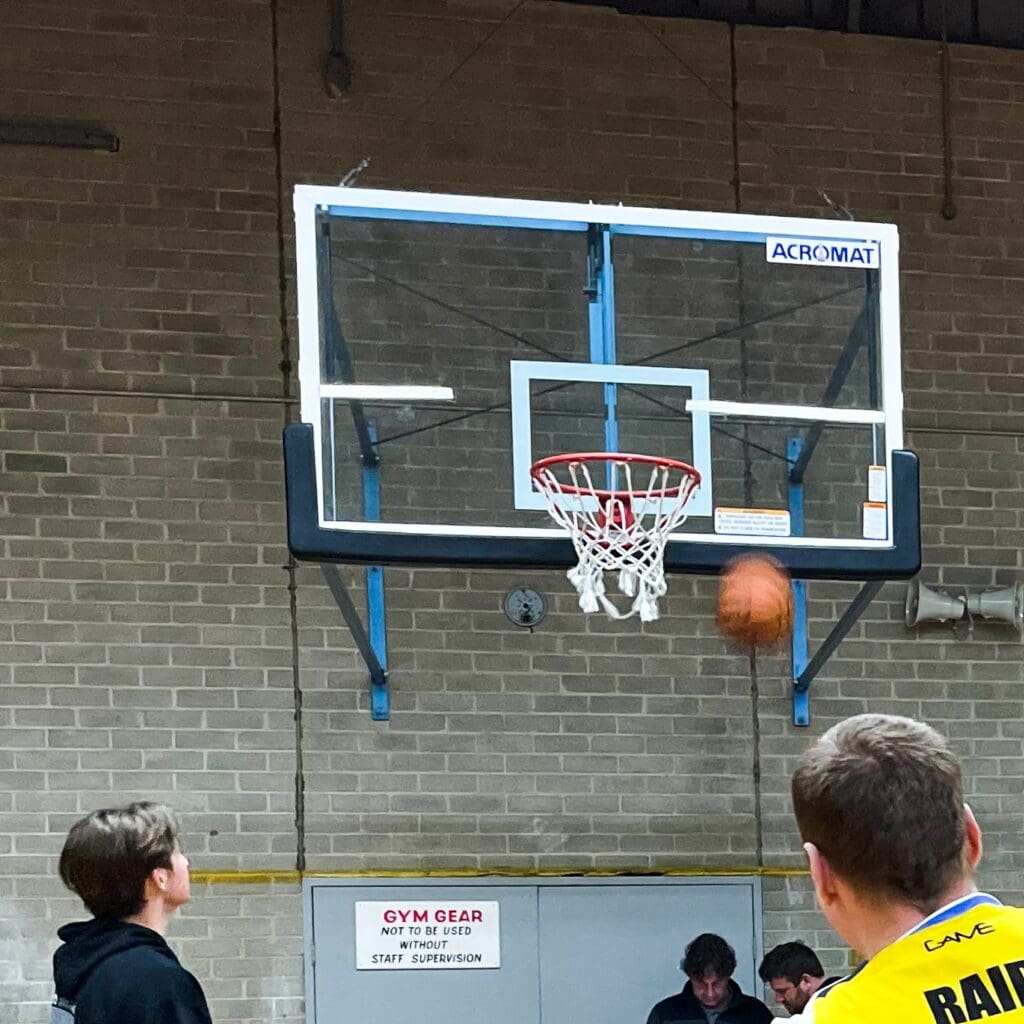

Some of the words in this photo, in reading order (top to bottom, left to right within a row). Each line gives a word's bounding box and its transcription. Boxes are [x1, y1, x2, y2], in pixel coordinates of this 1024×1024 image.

[772, 243, 875, 264] ACROMAT
[383, 909, 429, 923] GYM
[434, 909, 483, 922] GEAR
[380, 926, 404, 936] NOT
[408, 926, 422, 935] TO
[425, 926, 437, 935] BE
[443, 926, 472, 936] USED
[924, 922, 996, 952] GAME
[400, 940, 449, 950] WITHOUT
[371, 953, 404, 964] STAFF
[411, 953, 482, 964] SUPERVISION
